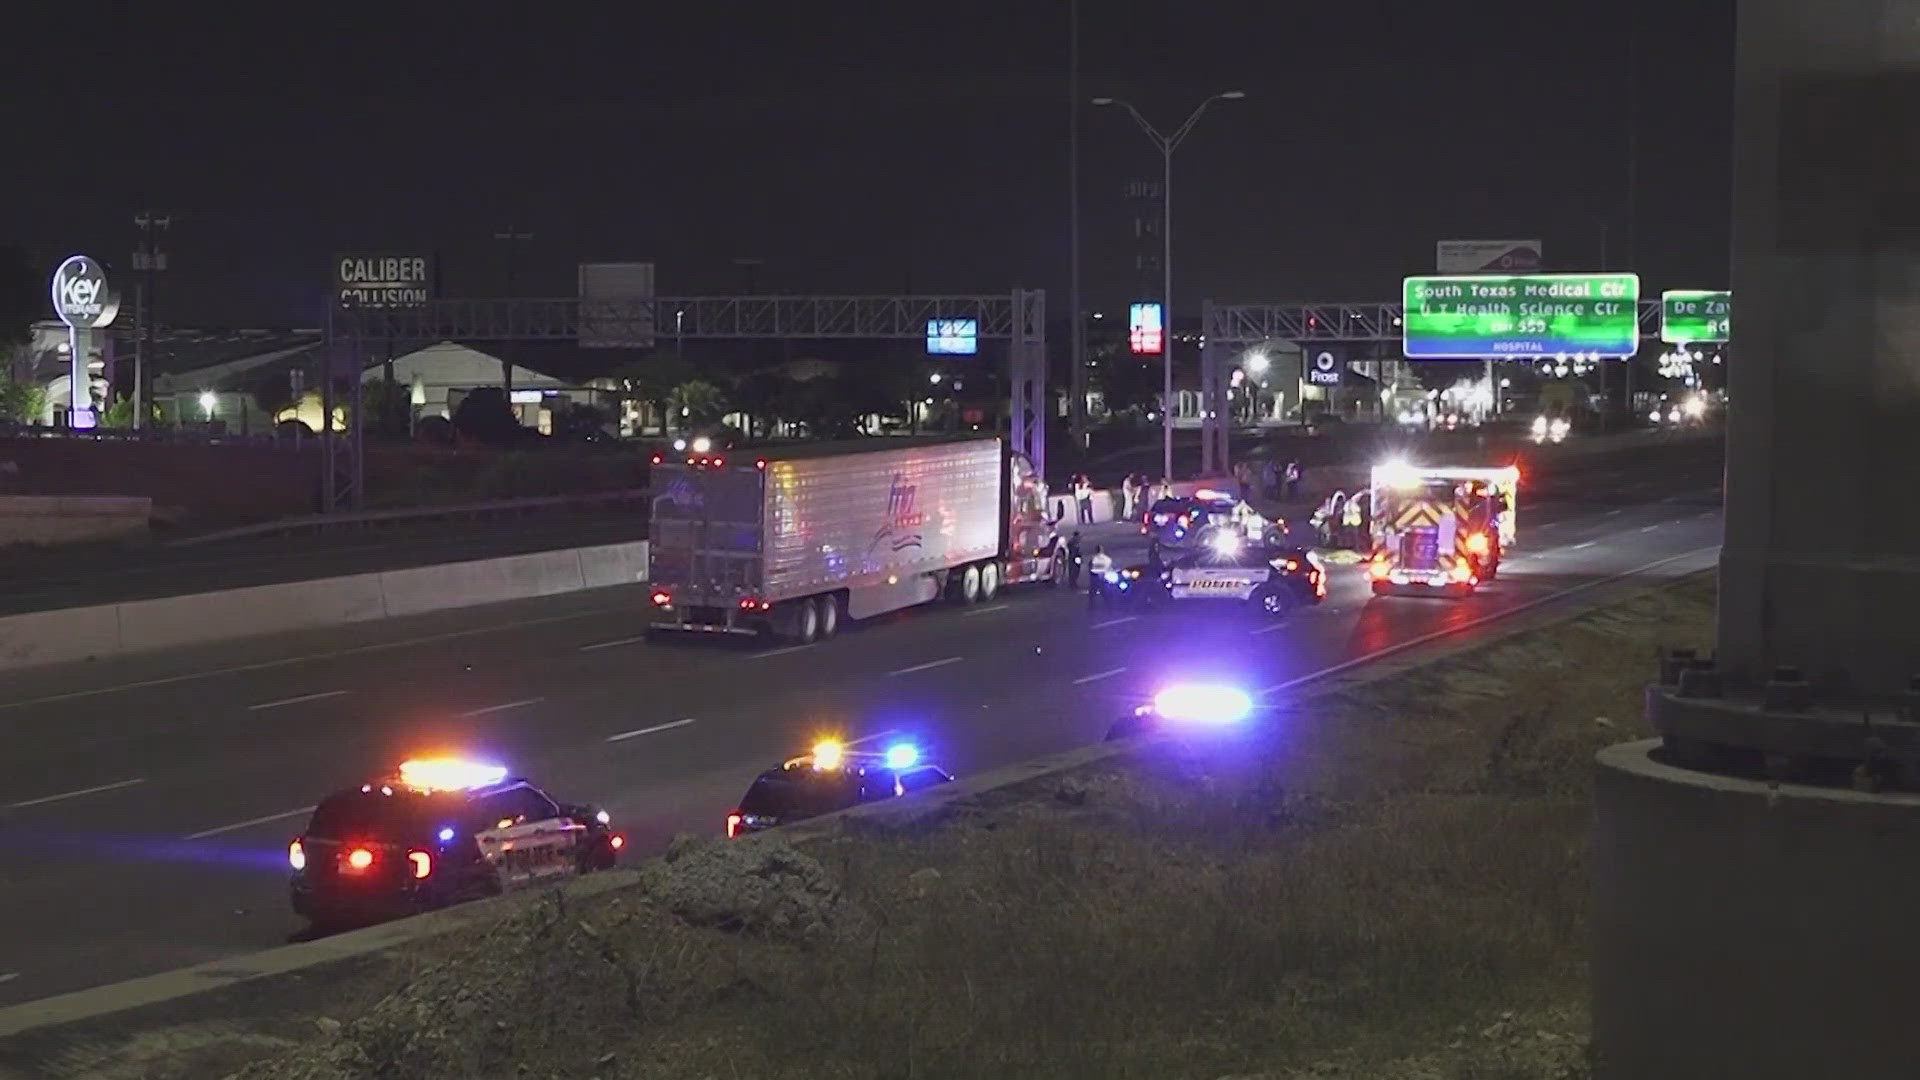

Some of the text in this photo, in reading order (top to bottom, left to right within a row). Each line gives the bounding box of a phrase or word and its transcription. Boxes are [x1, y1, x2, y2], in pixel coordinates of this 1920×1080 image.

[341, 257, 425, 281] CALIBER
[341, 288, 427, 308] COLLISION
[1415, 282, 1625, 299] South Texas Medical Ctr
[1421, 303, 1431, 317] U
[1456, 303, 1511, 317] Health
[1519, 302, 1584, 316] Science
[1594, 302, 1620, 316] Ctr
[1674, 301, 1697, 314] De
[1493, 341, 1544, 352] HOSPITAL
[1311, 369, 1340, 382] Frost
